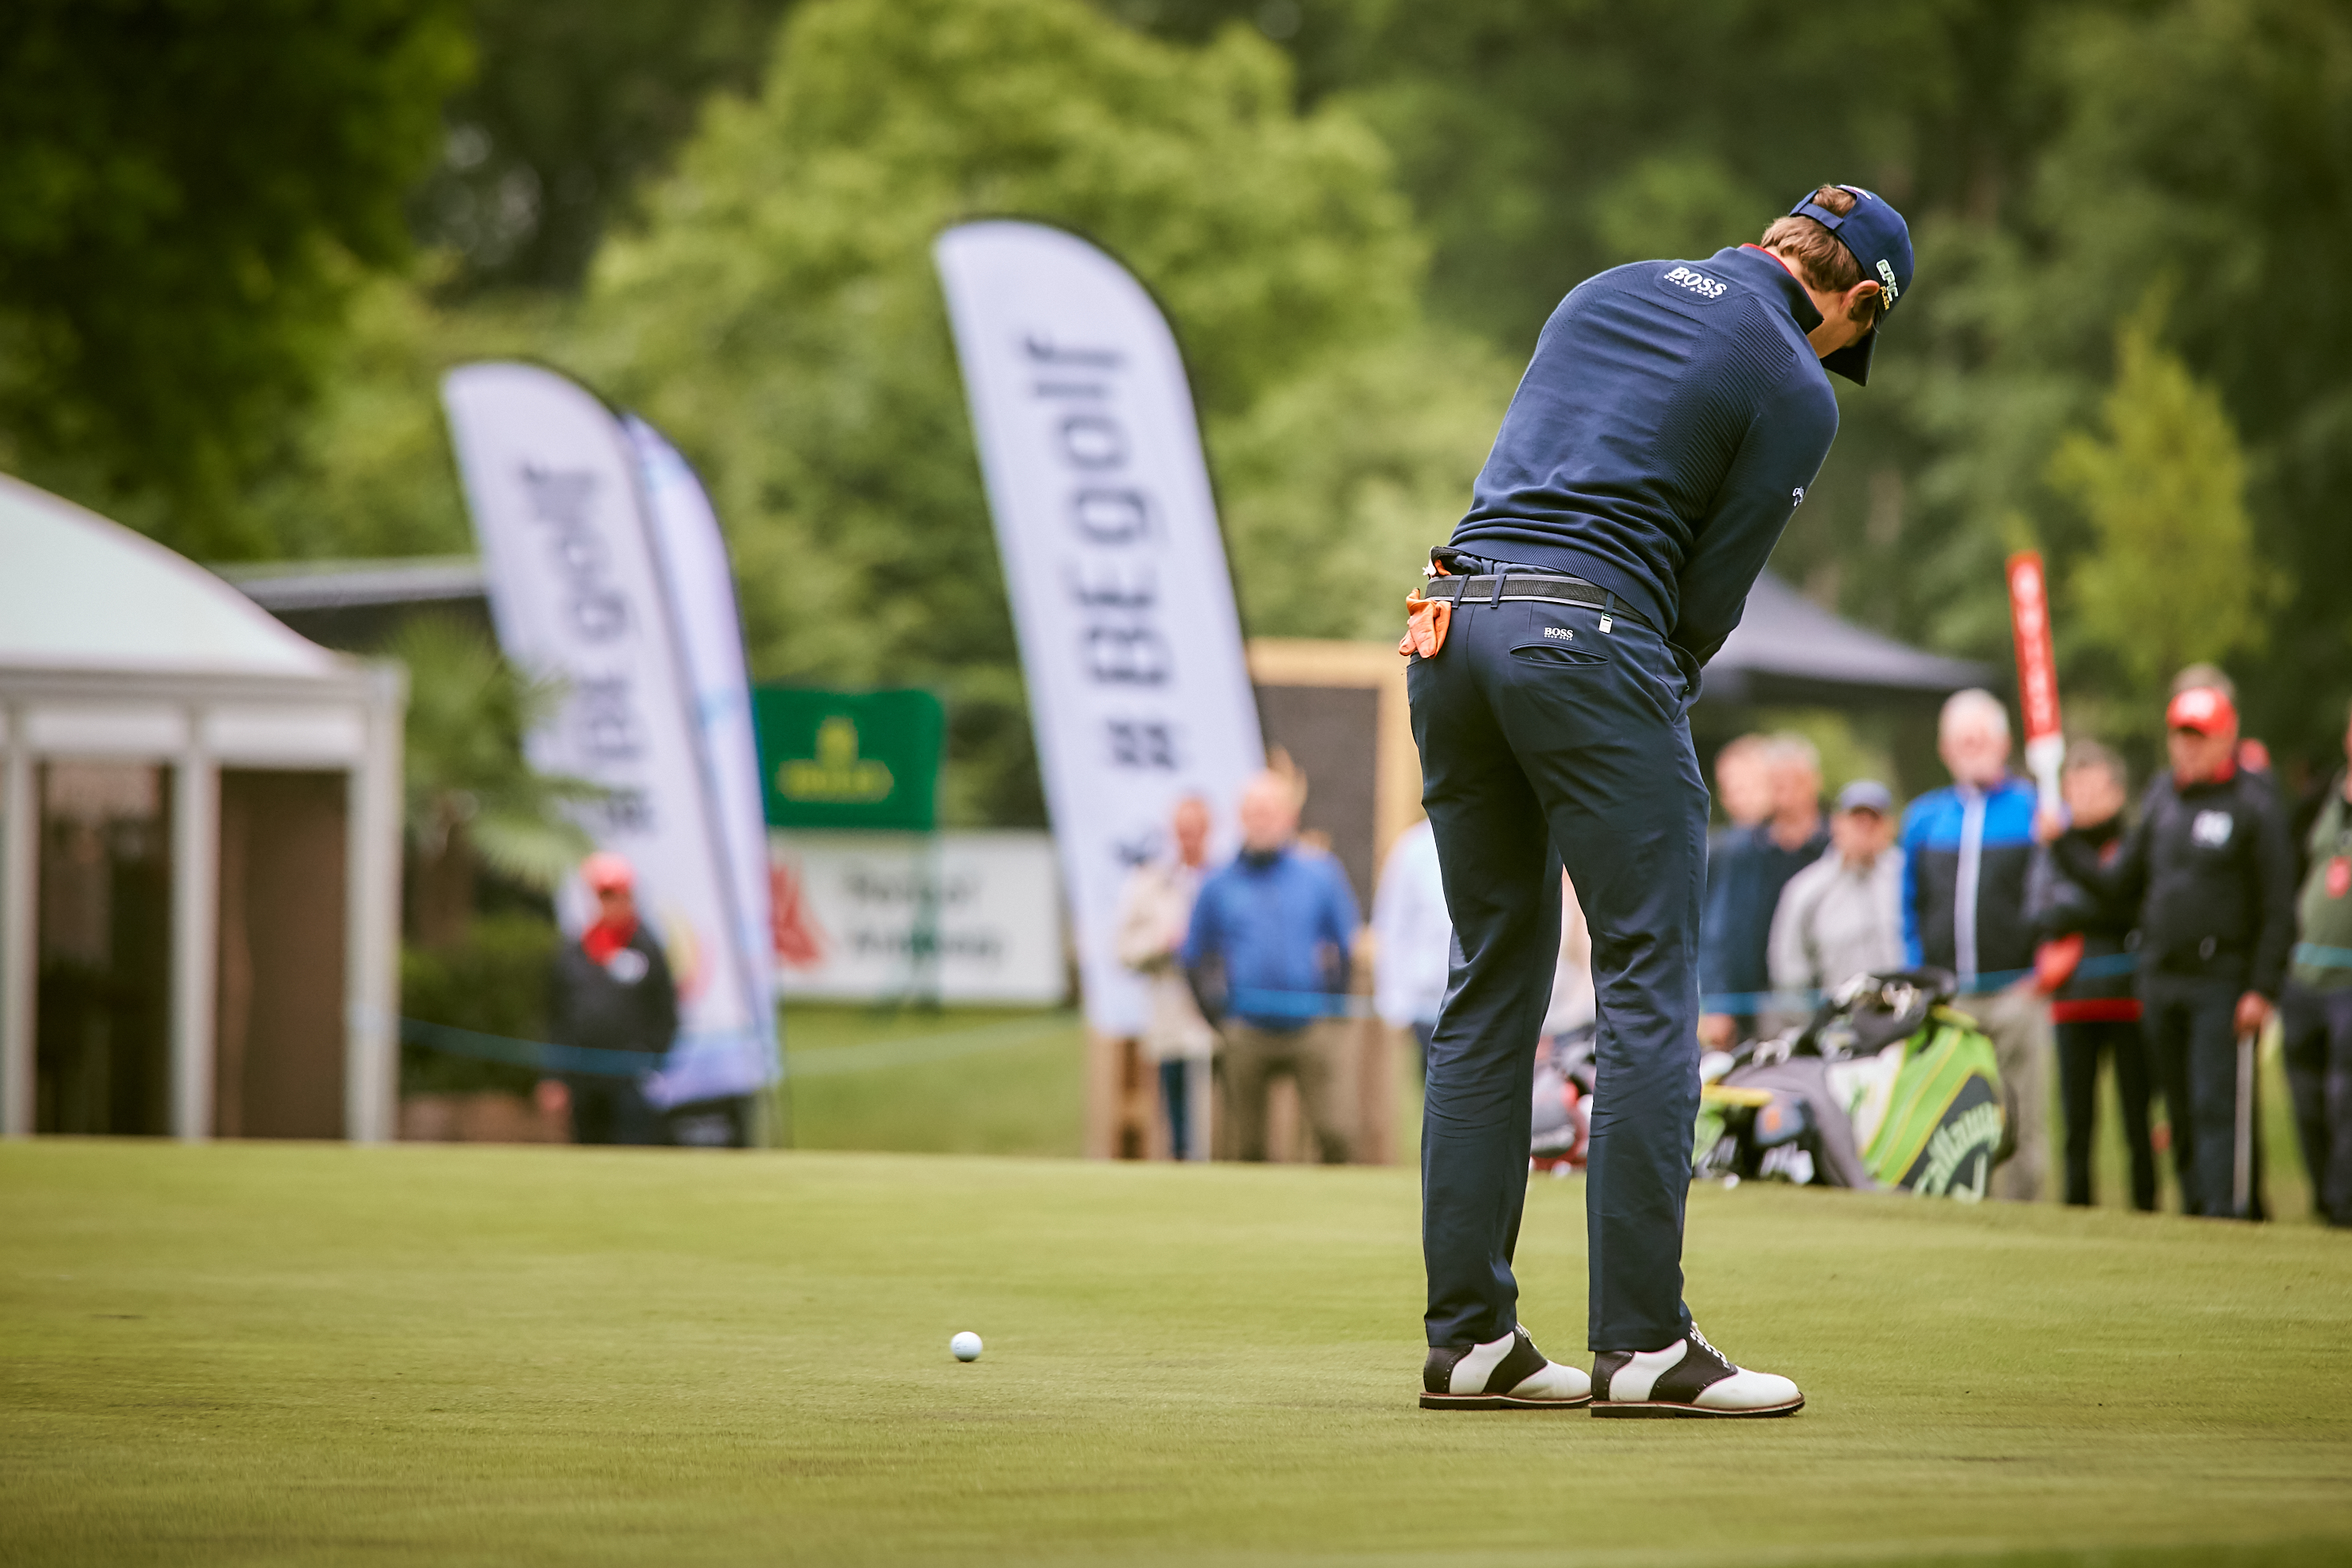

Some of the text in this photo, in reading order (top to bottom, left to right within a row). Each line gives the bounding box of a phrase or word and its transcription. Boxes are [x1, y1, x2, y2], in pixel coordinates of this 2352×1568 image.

[1668, 266, 1728, 296] BOSS
[1877, 259, 1899, 302] EPIC
[1544, 627, 1574, 638] BOSS
